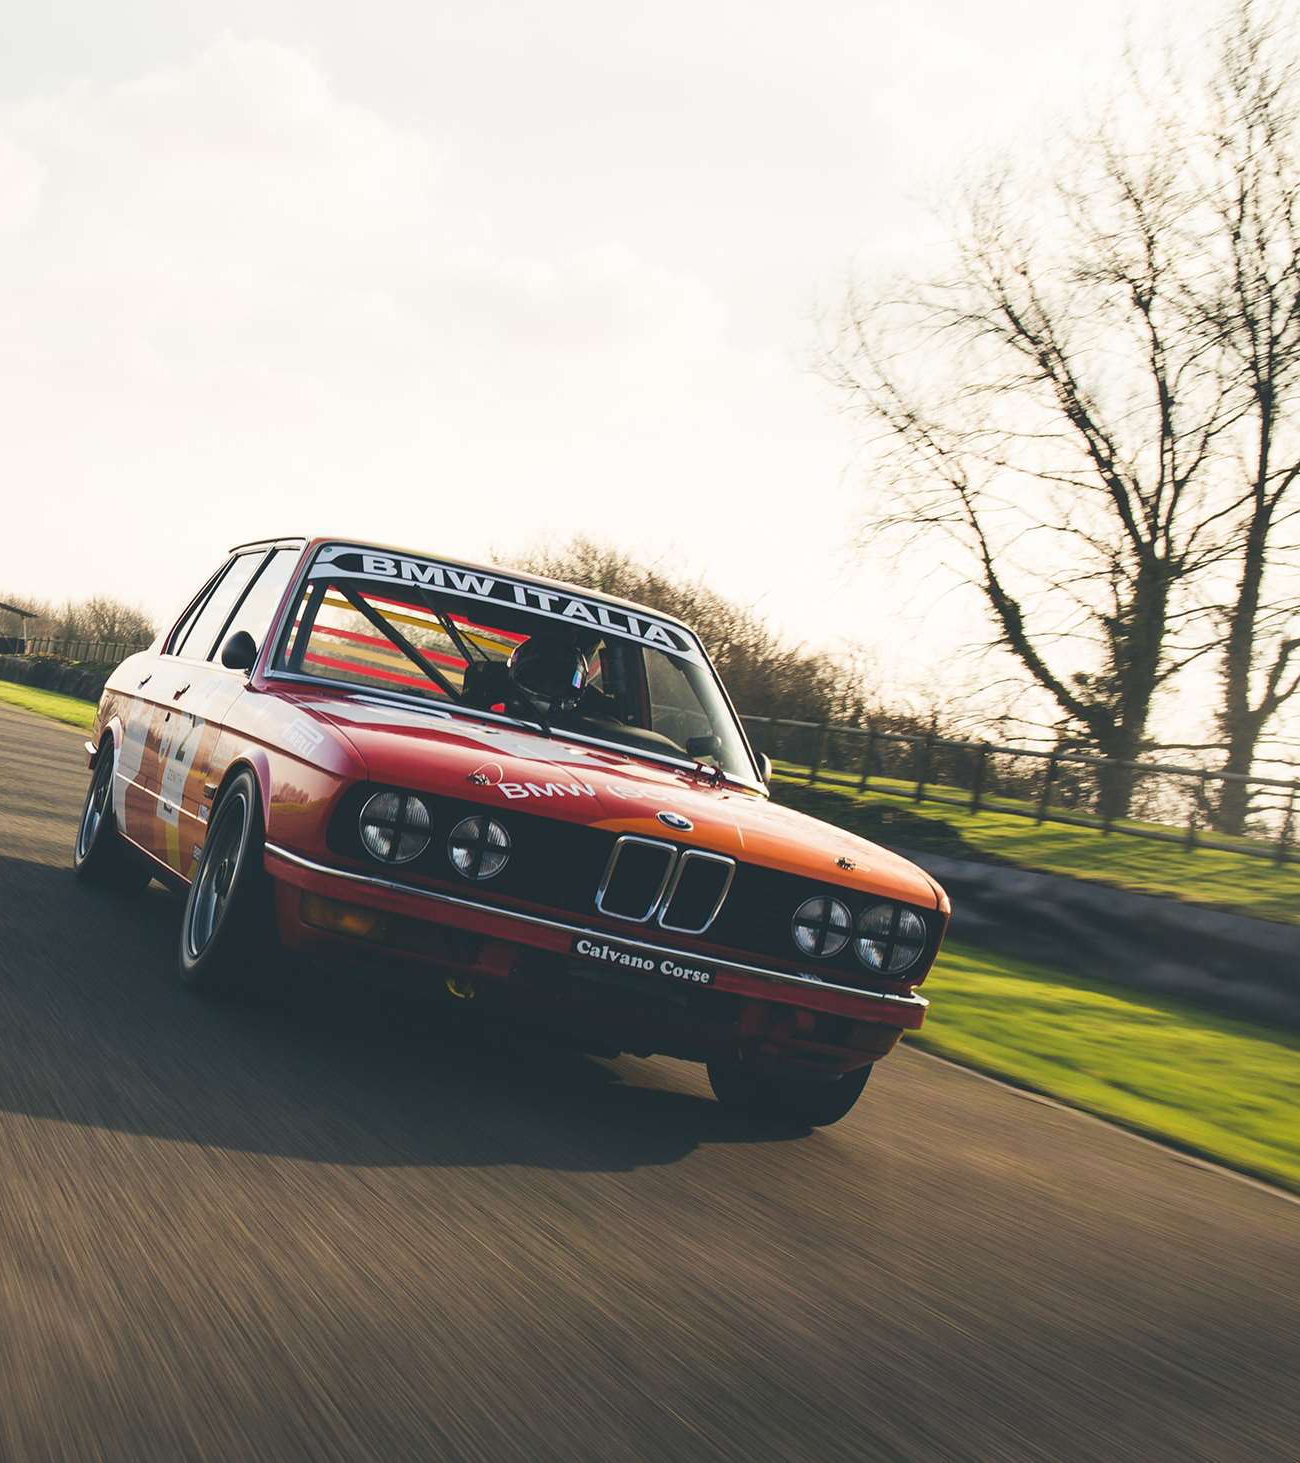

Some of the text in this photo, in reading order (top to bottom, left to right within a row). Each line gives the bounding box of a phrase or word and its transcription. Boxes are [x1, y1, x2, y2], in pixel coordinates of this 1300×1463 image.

[362, 554, 679, 650] BMW ITALIA
[498, 782, 597, 800] BMW
[576, 939, 711, 984] Calvano Corse
